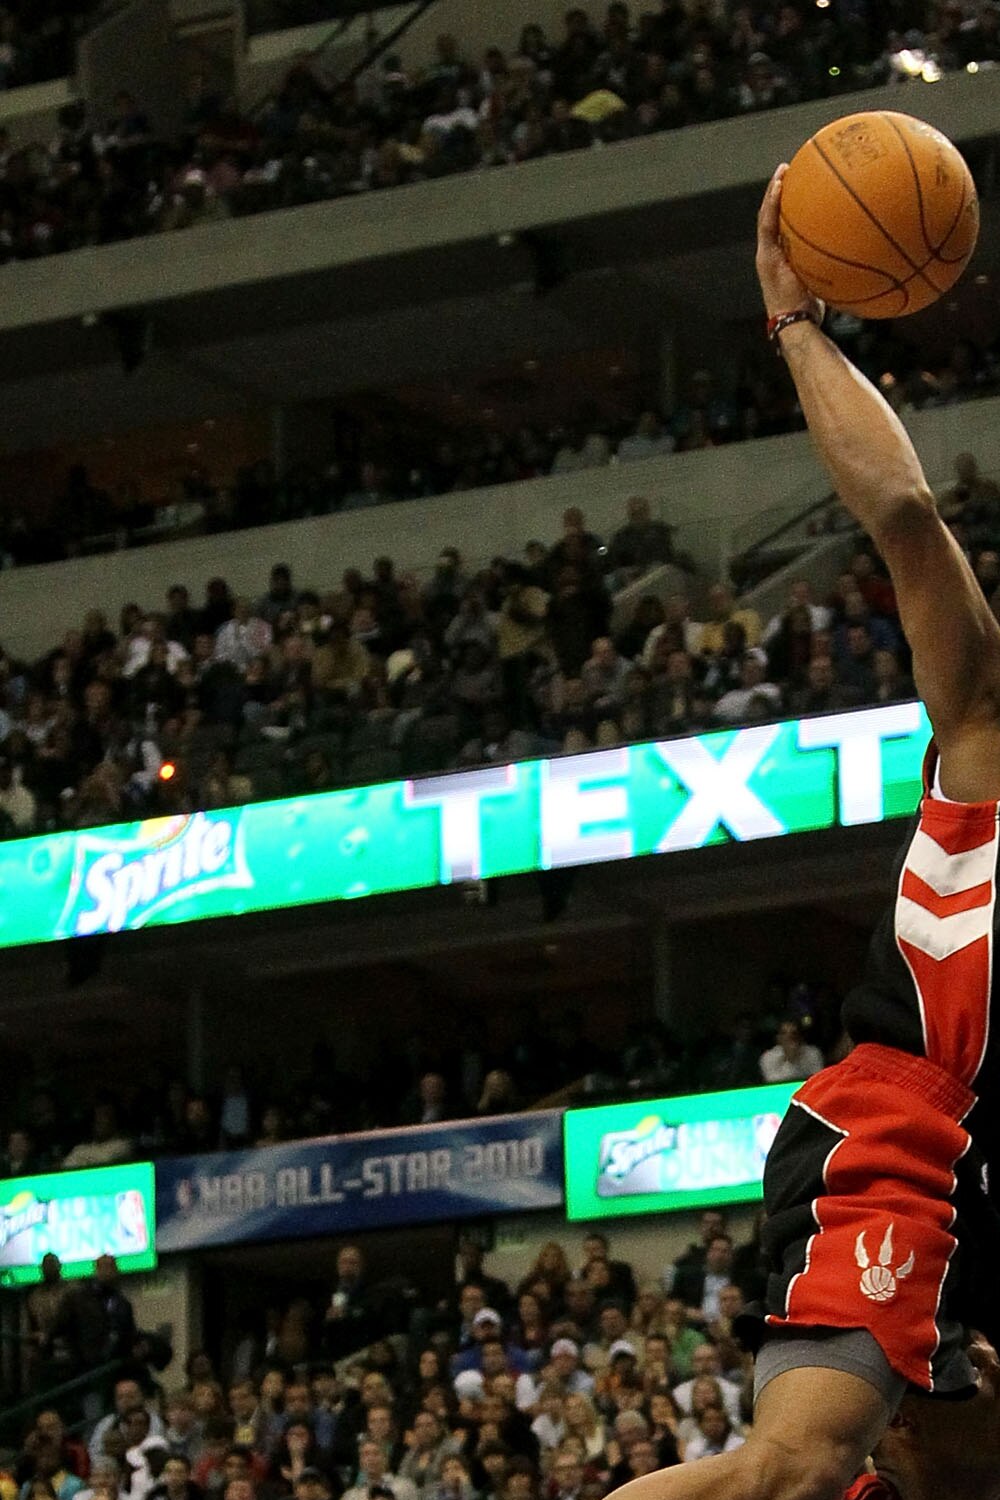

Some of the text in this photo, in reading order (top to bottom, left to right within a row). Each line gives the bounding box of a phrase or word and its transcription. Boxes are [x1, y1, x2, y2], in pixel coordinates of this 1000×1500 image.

[403, 701, 921, 885] TEXT
[75, 811, 232, 936] Sprite
[200, 1137, 544, 1212] NBA ALL-STAR 2010
